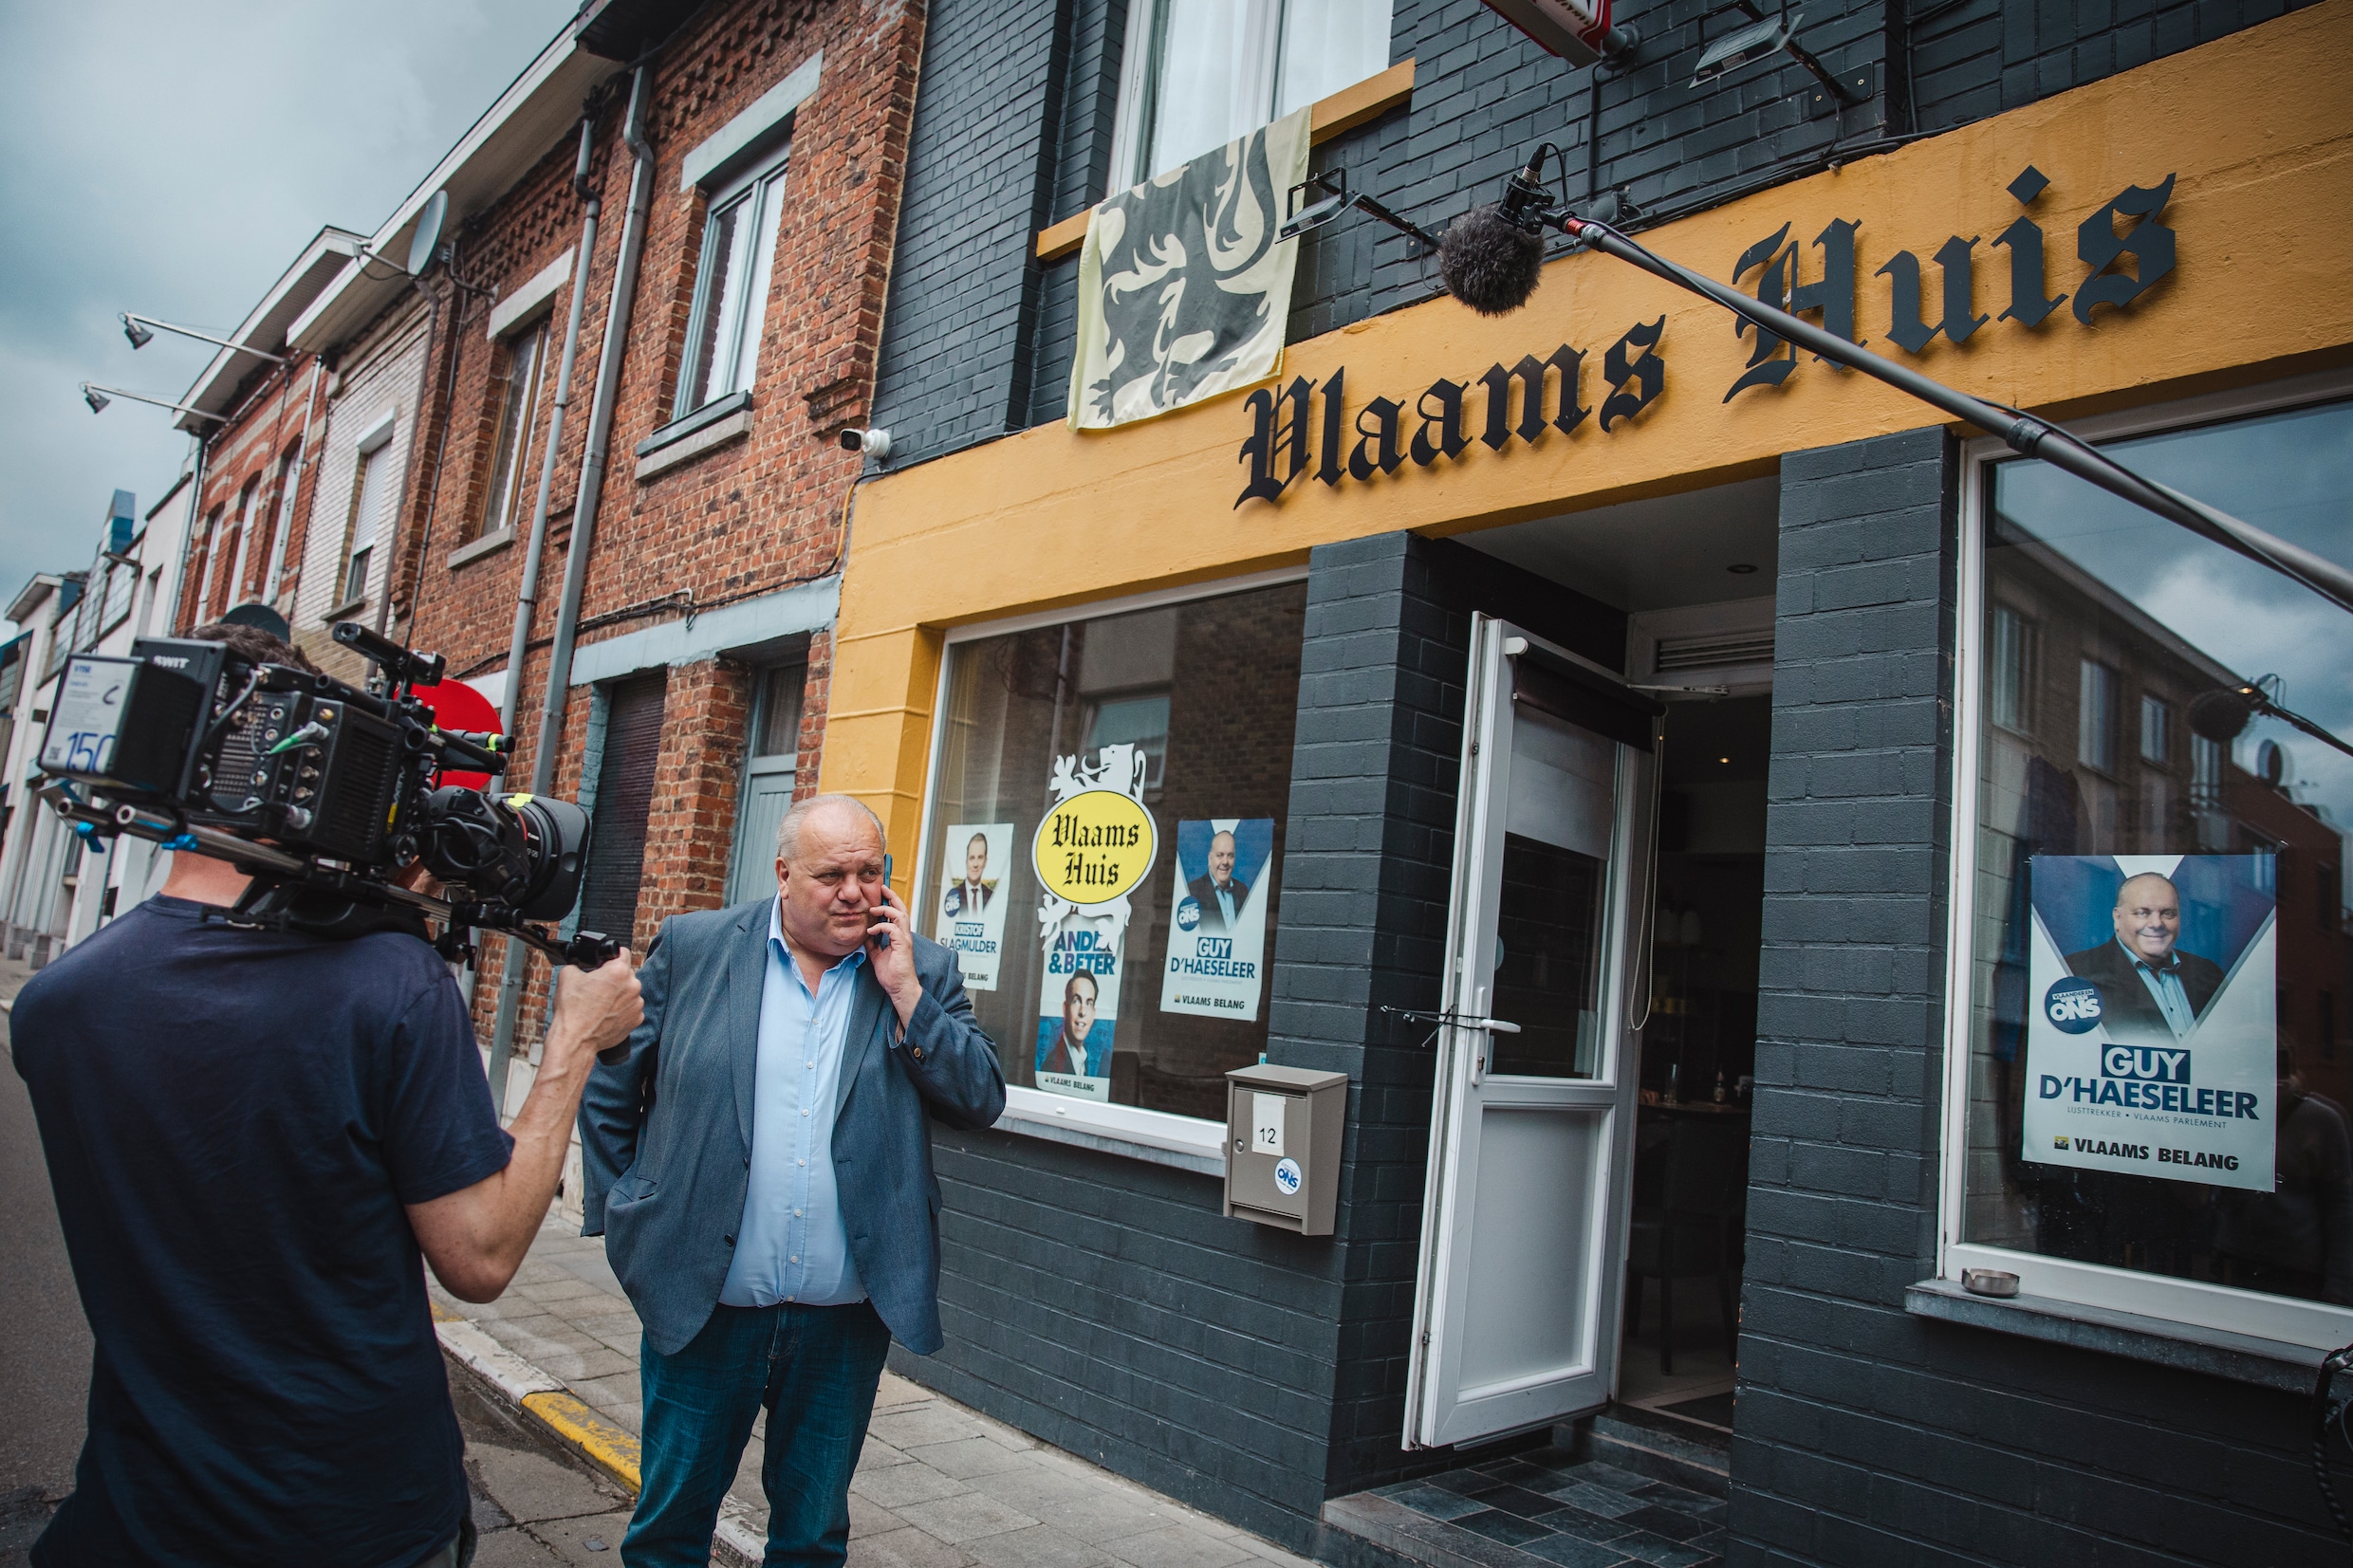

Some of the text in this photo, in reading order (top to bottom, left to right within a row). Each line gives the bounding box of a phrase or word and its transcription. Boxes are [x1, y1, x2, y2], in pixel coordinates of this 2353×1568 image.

[1233, 164, 2177, 510] Vlaams Huis
[1051, 813, 1140, 849] Vlaams
[1063, 852, 1121, 888] Huis
[1178, 908, 1201, 925] ONS
[1197, 937, 1232, 958] GUY
[968, 973, 989, 982] BELANG
[1182, 995, 1245, 1009] VLAAMS BELANG
[2053, 989, 2093, 1000] VLAANDEREN
[2049, 998, 2102, 1022] ONS
[2104, 1046, 2187, 1080] GUY
[1050, 1077, 1095, 1092] VLAAMS BELANG
[2039, 1074, 2260, 1121] D'HAESELEER
[2133, 1113, 2170, 1124] VLAAMS
[2173, 1116, 2228, 1130] PARLEMENT
[1259, 1127, 1276, 1144] 12
[2074, 1137, 2239, 1171] VLAAMS BELANG
[1277, 1168, 1299, 1189] ONS
